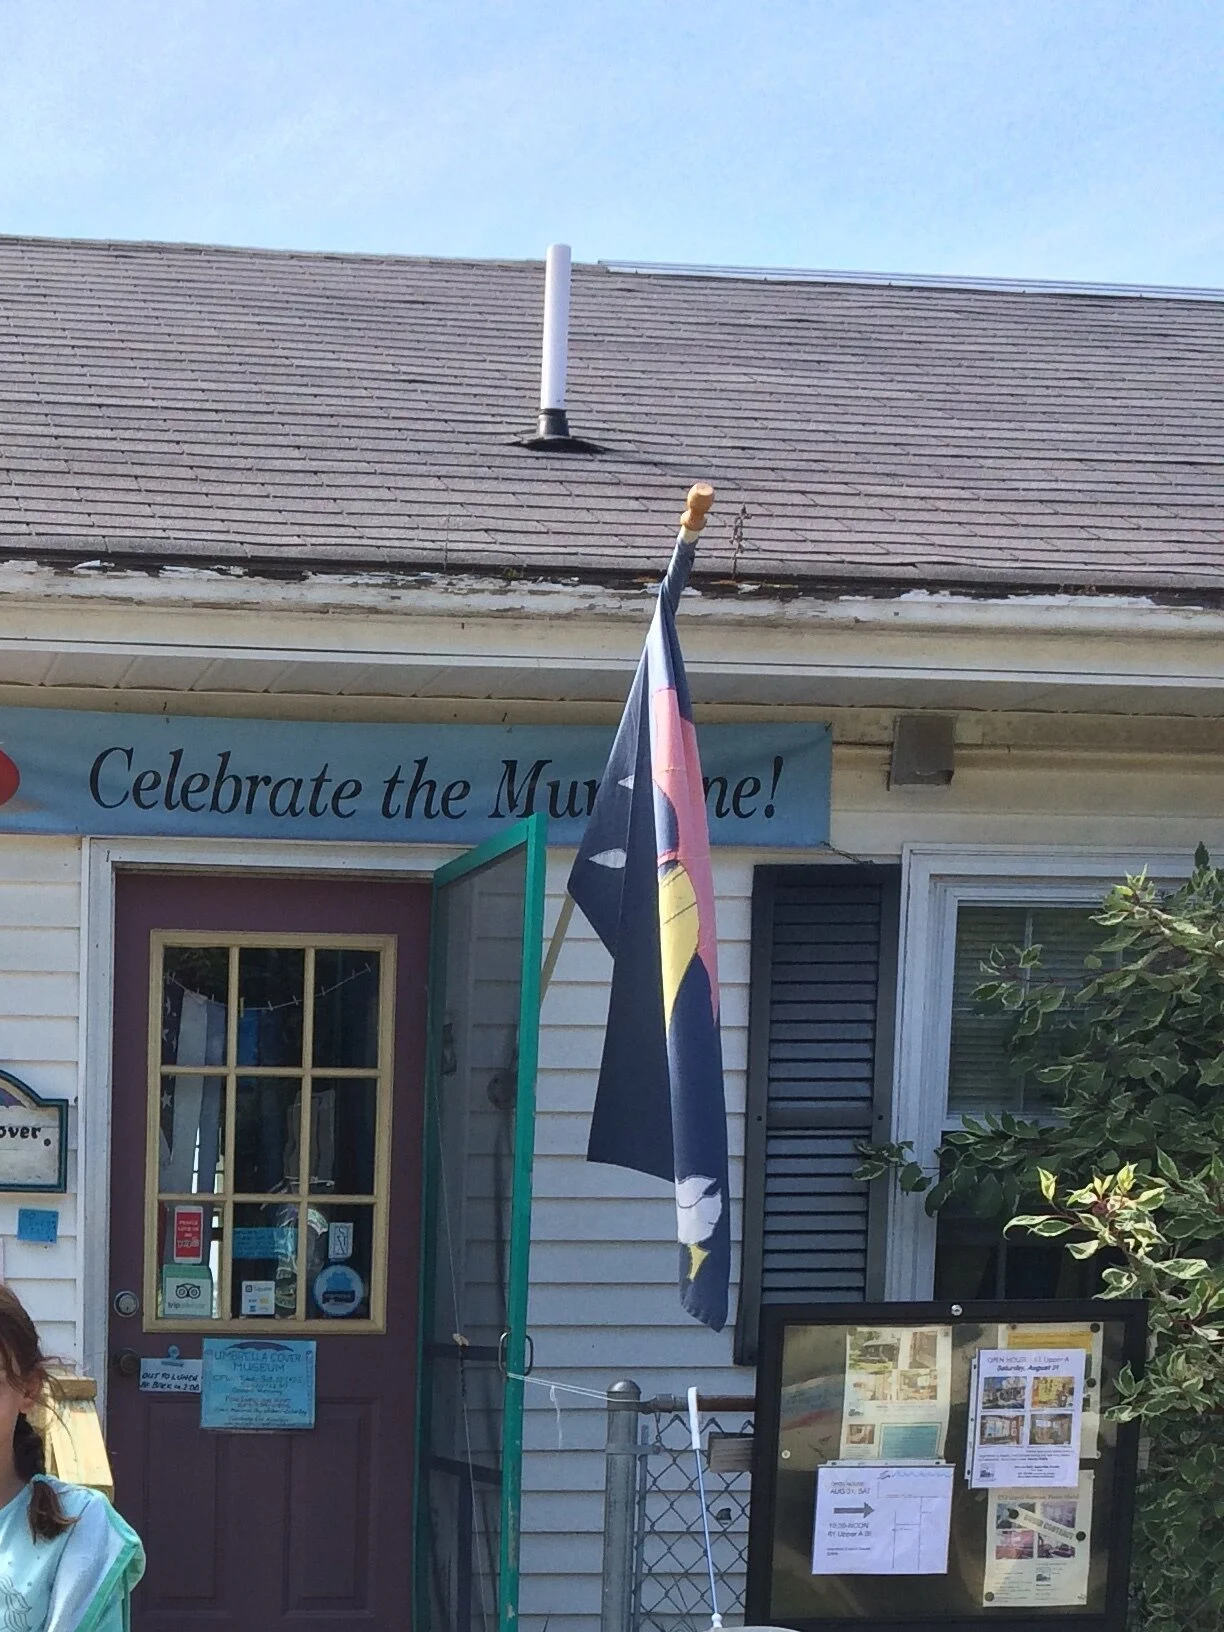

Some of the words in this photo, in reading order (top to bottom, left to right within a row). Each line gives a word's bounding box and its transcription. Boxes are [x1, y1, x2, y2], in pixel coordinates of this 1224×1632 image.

[88, 746, 363, 819] Celebrate
[381, 756, 471, 820] the
[233, 1362, 285, 1372] MUSEUM
